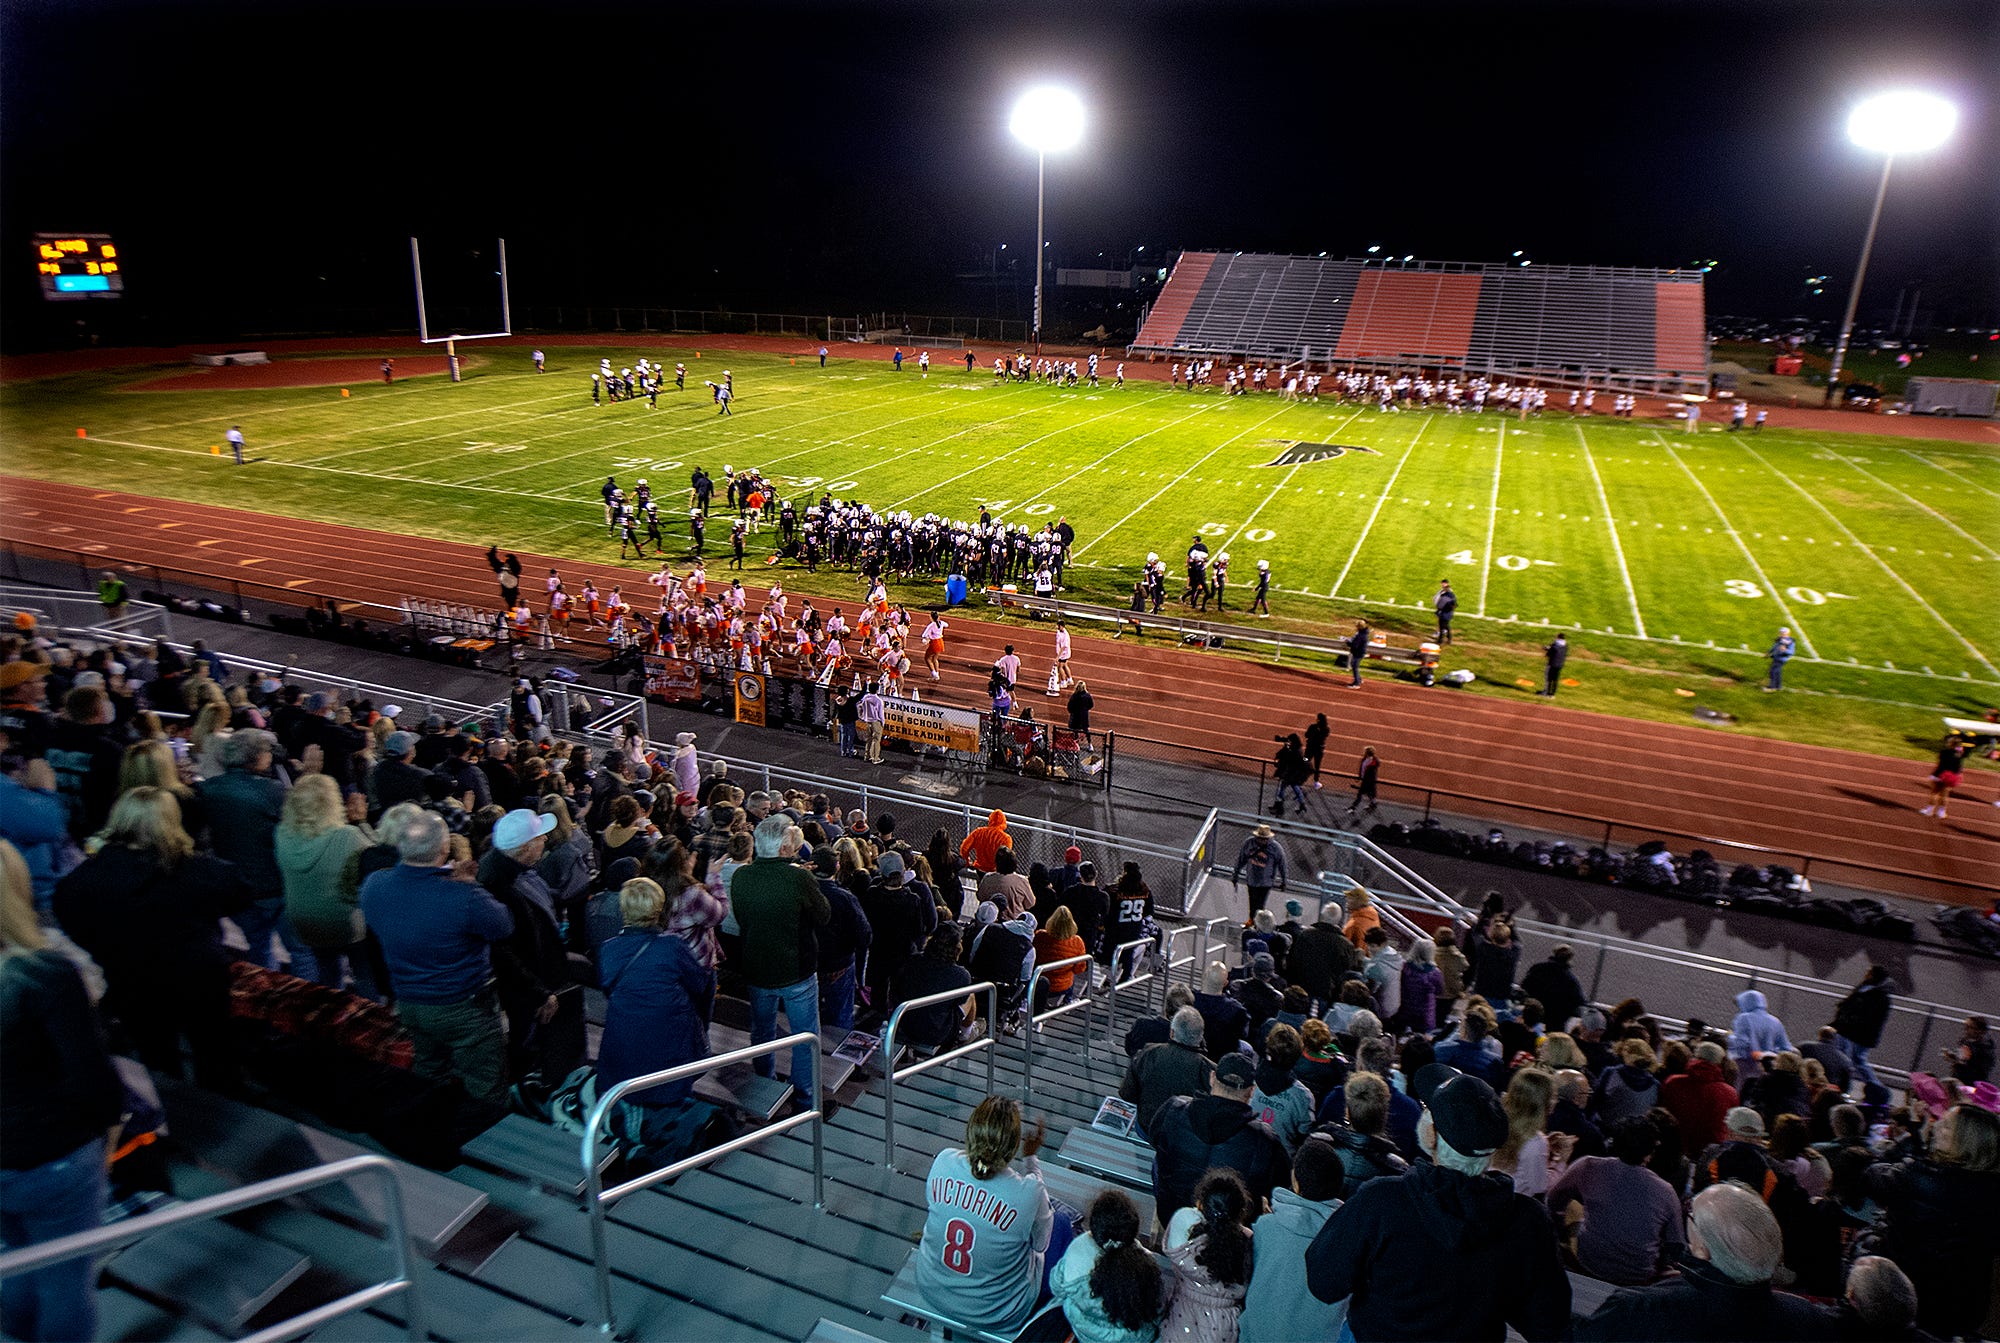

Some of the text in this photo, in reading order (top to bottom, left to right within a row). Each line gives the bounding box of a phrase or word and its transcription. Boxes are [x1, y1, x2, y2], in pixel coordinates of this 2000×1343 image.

[1197, 522, 1277, 542] 50
[1445, 549, 1531, 571] 40
[1724, 579, 1828, 606] 30
[883, 700, 945, 719] PENNSBURY
[883, 723, 952, 743] HEERLEADING
[906, 716, 945, 731] SCHOOL
[1118, 899, 1146, 923] 29
[931, 1177, 1019, 1233] VICTORINO
[941, 1217, 977, 1276] 8
